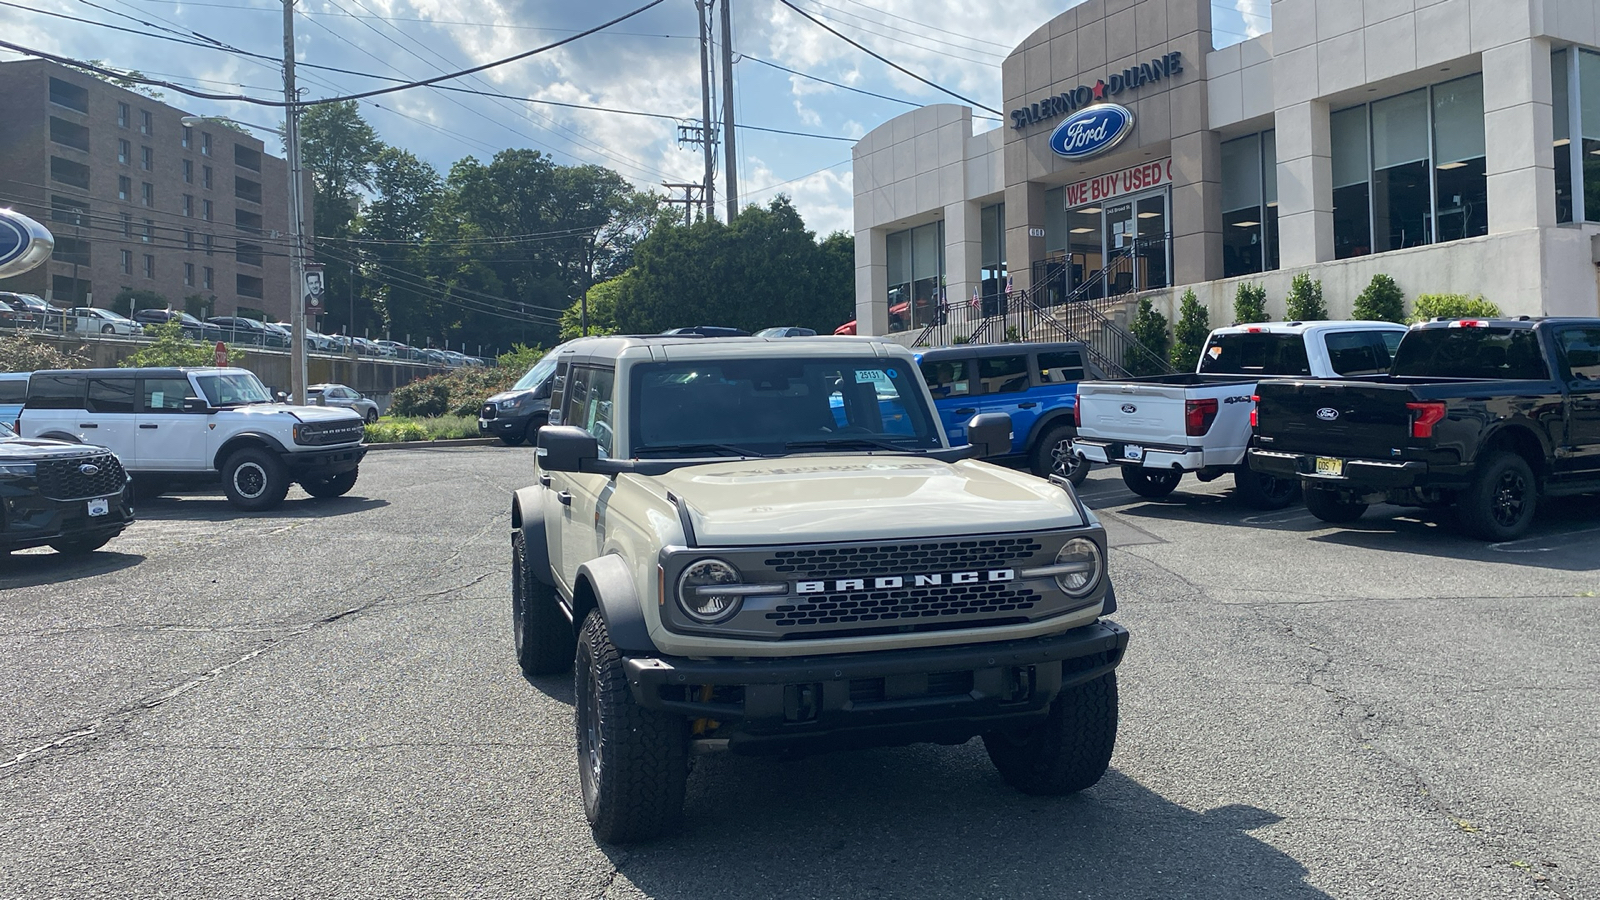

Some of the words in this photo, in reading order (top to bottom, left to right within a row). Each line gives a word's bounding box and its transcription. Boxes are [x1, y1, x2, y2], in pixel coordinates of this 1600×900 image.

[1010, 85, 1094, 129] SALERNO
[1108, 51, 1184, 96] DUANE
[1063, 115, 1109, 151] Ford
[1067, 182, 1088, 206] WE
[1091, 173, 1119, 201] BUY
[1123, 162, 1162, 192] USED
[859, 370, 880, 379] 25131
[796, 569, 1015, 593] BRONCO
